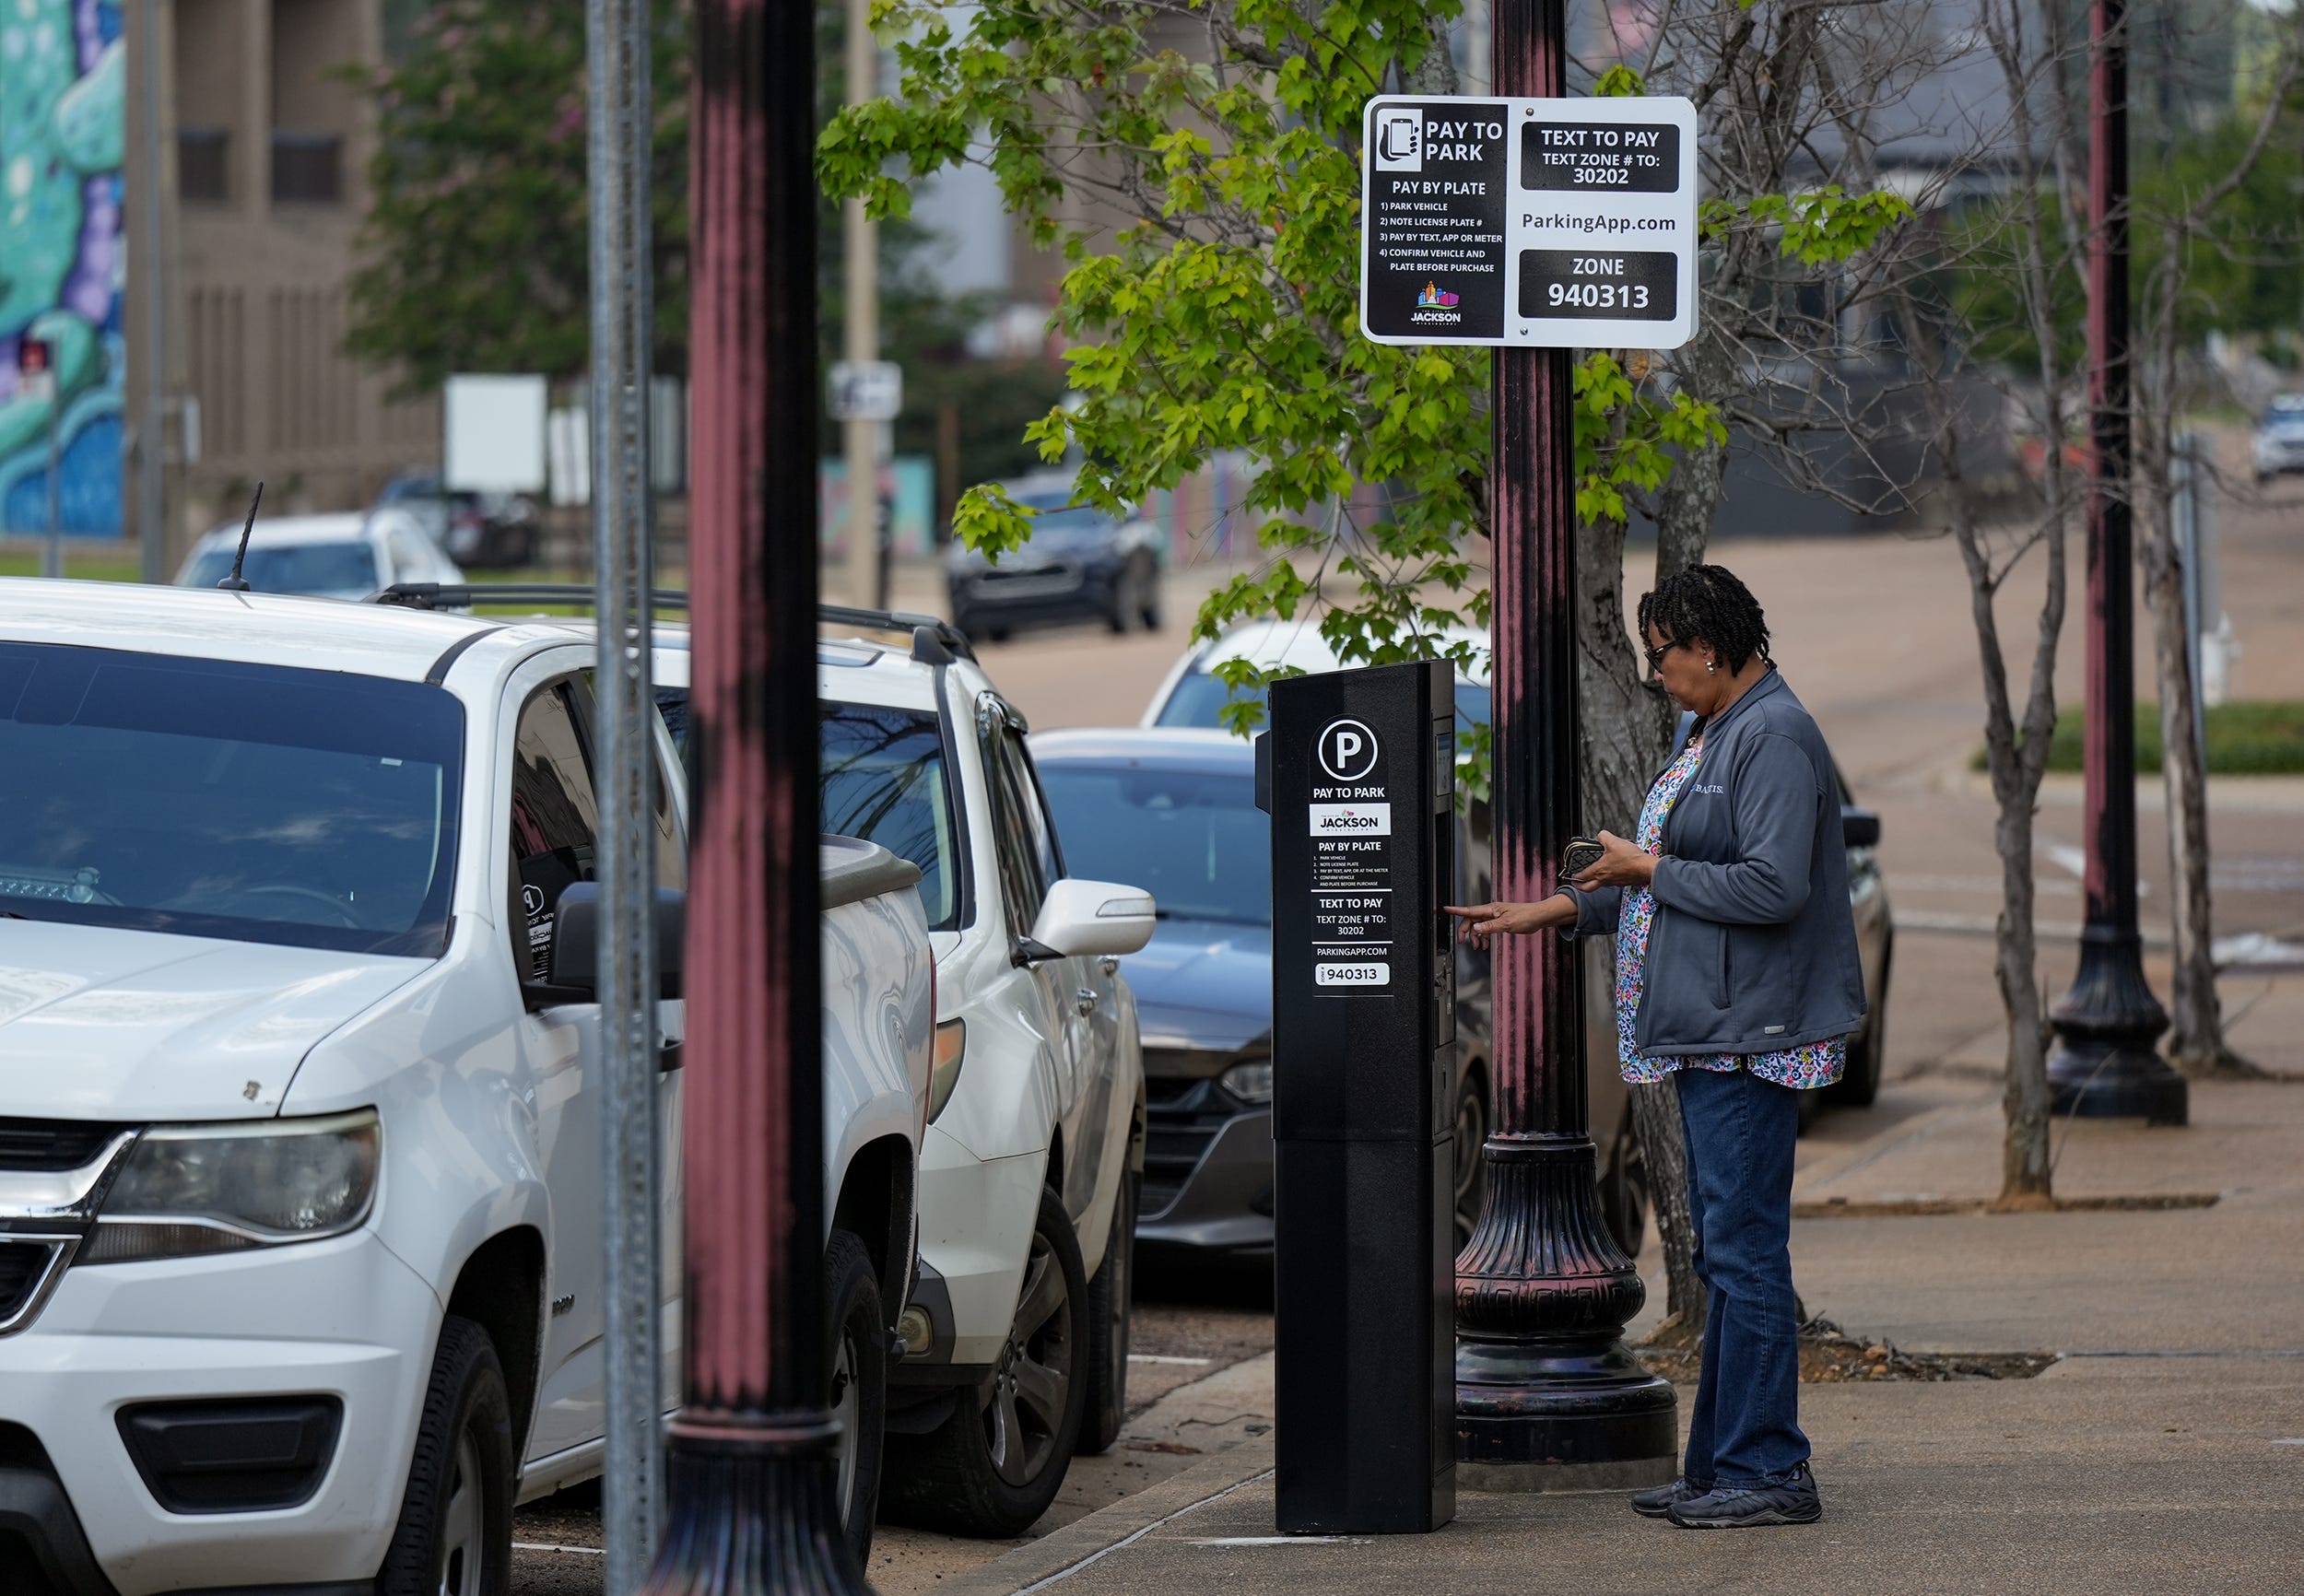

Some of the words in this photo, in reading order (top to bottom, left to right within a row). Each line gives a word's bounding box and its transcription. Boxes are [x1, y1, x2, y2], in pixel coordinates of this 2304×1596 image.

[1427, 122, 1468, 139] PAY
[1474, 123, 1502, 139] TO
[1541, 130, 1587, 147] TEXT
[1593, 131, 1618, 147] TO
[1625, 132, 1660, 147] PAY
[1426, 144, 1483, 161] PARK
[1542, 153, 1577, 165] TEXT
[1580, 154, 1619, 166] ZONE
[1623, 155, 1633, 166] #
[1636, 155, 1660, 167] TO:
[1573, 168, 1629, 184] 30202
[1393, 181, 1419, 194] PAY
[1423, 182, 1440, 194] BY
[1444, 182, 1486, 195] PLATE
[1381, 203, 1388, 211] 1)
[1414, 203, 1448, 211] VEHICLE
[1380, 217, 1388, 227] 2)
[1390, 217, 1413, 226] NOTE
[1415, 218, 1449, 227] LICENSE
[1450, 218, 1475, 227] PLATE
[1522, 213, 1675, 233] ParkingApp.com
[1380, 233, 1388, 241] 3)
[1406, 233, 1417, 241] BY
[1419, 233, 1441, 242] TEXT,
[1442, 234, 1459, 242] APP
[1461, 234, 1473, 242] OR
[1379, 249, 1388, 257] 4)
[1389, 249, 1428, 257] CONFIRM
[1430, 250, 1464, 258] VEHICLE
[1466, 250, 1486, 258] AND
[1390, 263, 1415, 271] PLATE
[1450, 264, 1495, 273] PURCHASE
[1572, 258, 1624, 276] ZONE
[1548, 283, 1649, 309] 940313
[1410, 312, 1461, 323] JACKSON
[1336, 732, 1362, 769] P
[1313, 788, 1334, 799] PAY
[1334, 788, 1352, 798] TO
[1355, 787, 1385, 798] PARK
[1320, 816, 1378, 828] JACKSON
[1319, 842, 1336, 851] PAY
[1337, 842, 1350, 851] BY
[1352, 841, 1381, 851] PLATE
[1319, 898, 1344, 909] TEXT
[1346, 898, 1361, 909] TO
[1364, 898, 1382, 908] PAY
[1316, 915, 1336, 923] TEXT
[1337, 915, 1362, 923] ZONE
[1364, 915, 1369, 923] #
[1370, 915, 1387, 923] TO:
[1337, 926, 1365, 935] 30202
[1317, 947, 1387, 956] PARKINGAPP.COM
[1327, 968, 1377, 980] 940313
